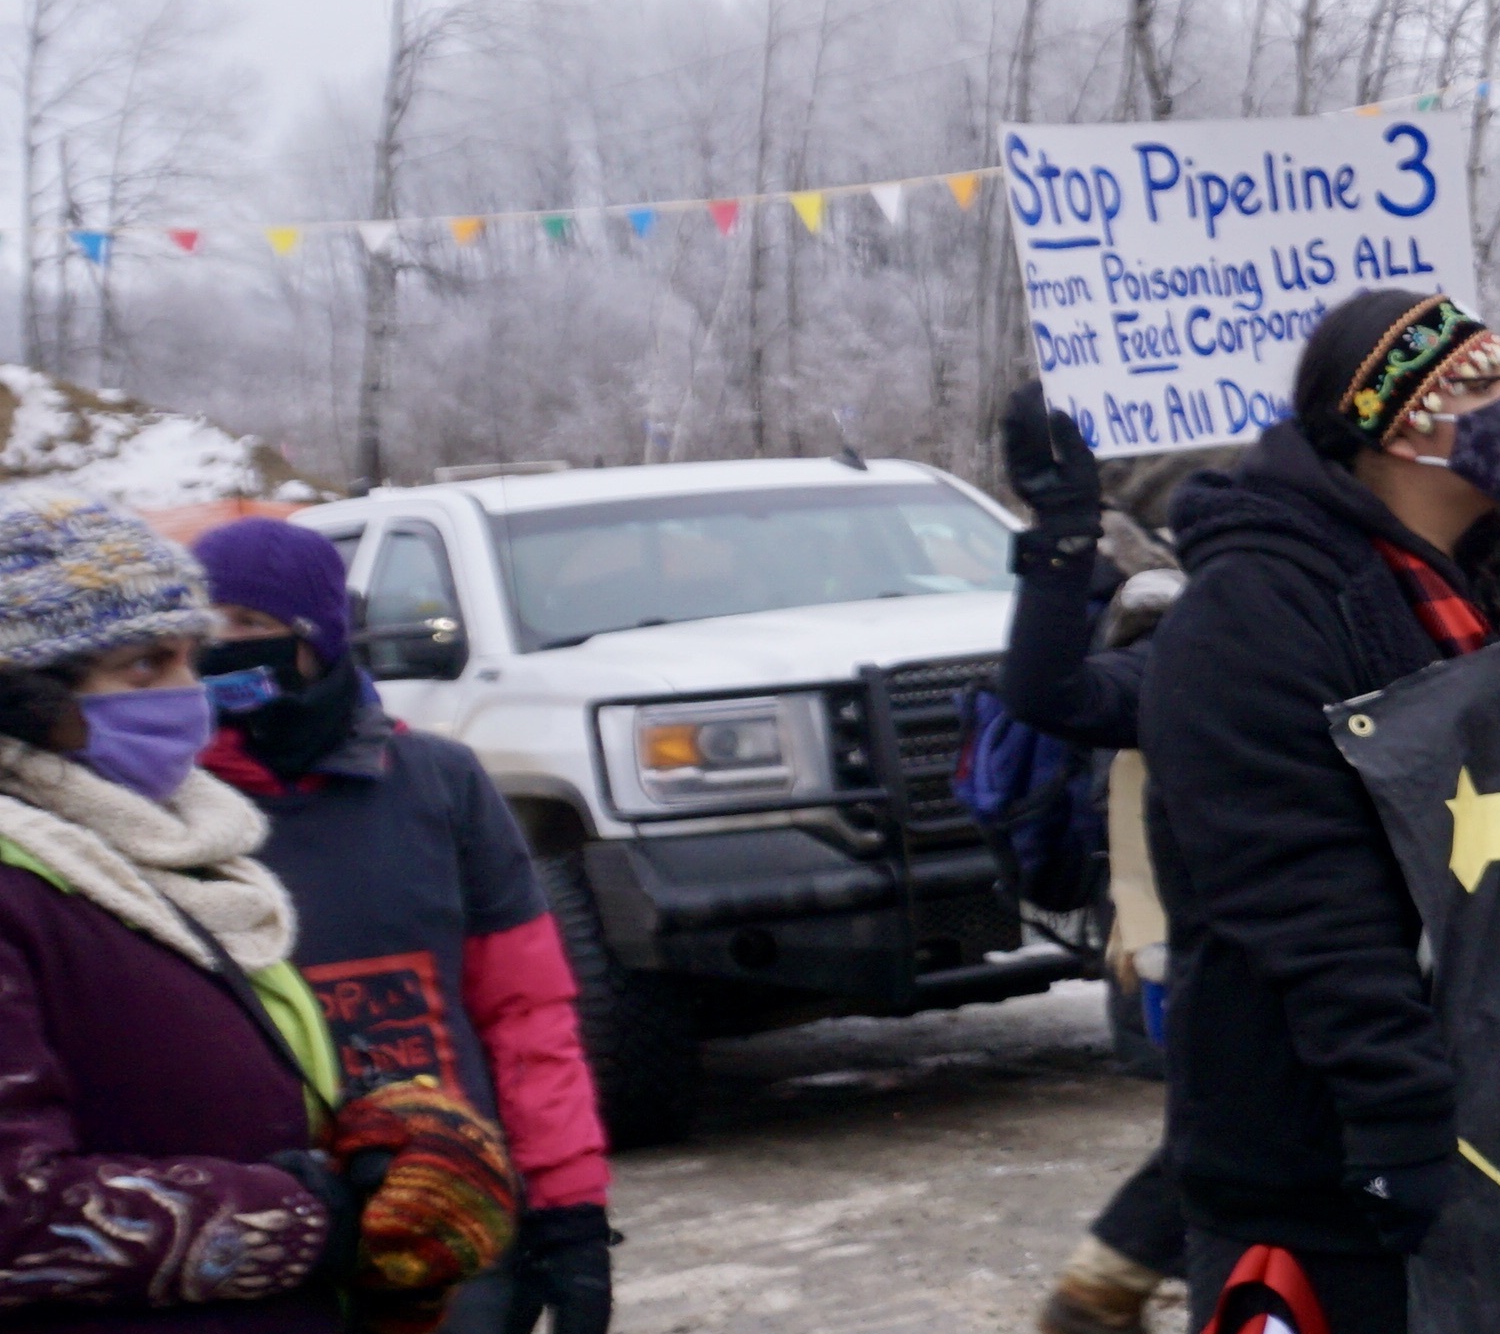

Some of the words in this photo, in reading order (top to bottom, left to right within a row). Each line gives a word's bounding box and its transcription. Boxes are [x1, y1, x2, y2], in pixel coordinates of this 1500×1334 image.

[1005, 131, 1121, 247] Stop
[1132, 142, 1360, 239] Pipeline
[1375, 122, 1437, 217] 3
[1025, 261, 1092, 309] from
[1101, 251, 1263, 311] Poisoning
[1353, 235, 1434, 279] ALL
[1111, 309, 1182, 364] Feed
[1103, 391, 1159, 445] Are
[1164, 383, 1214, 443] All
